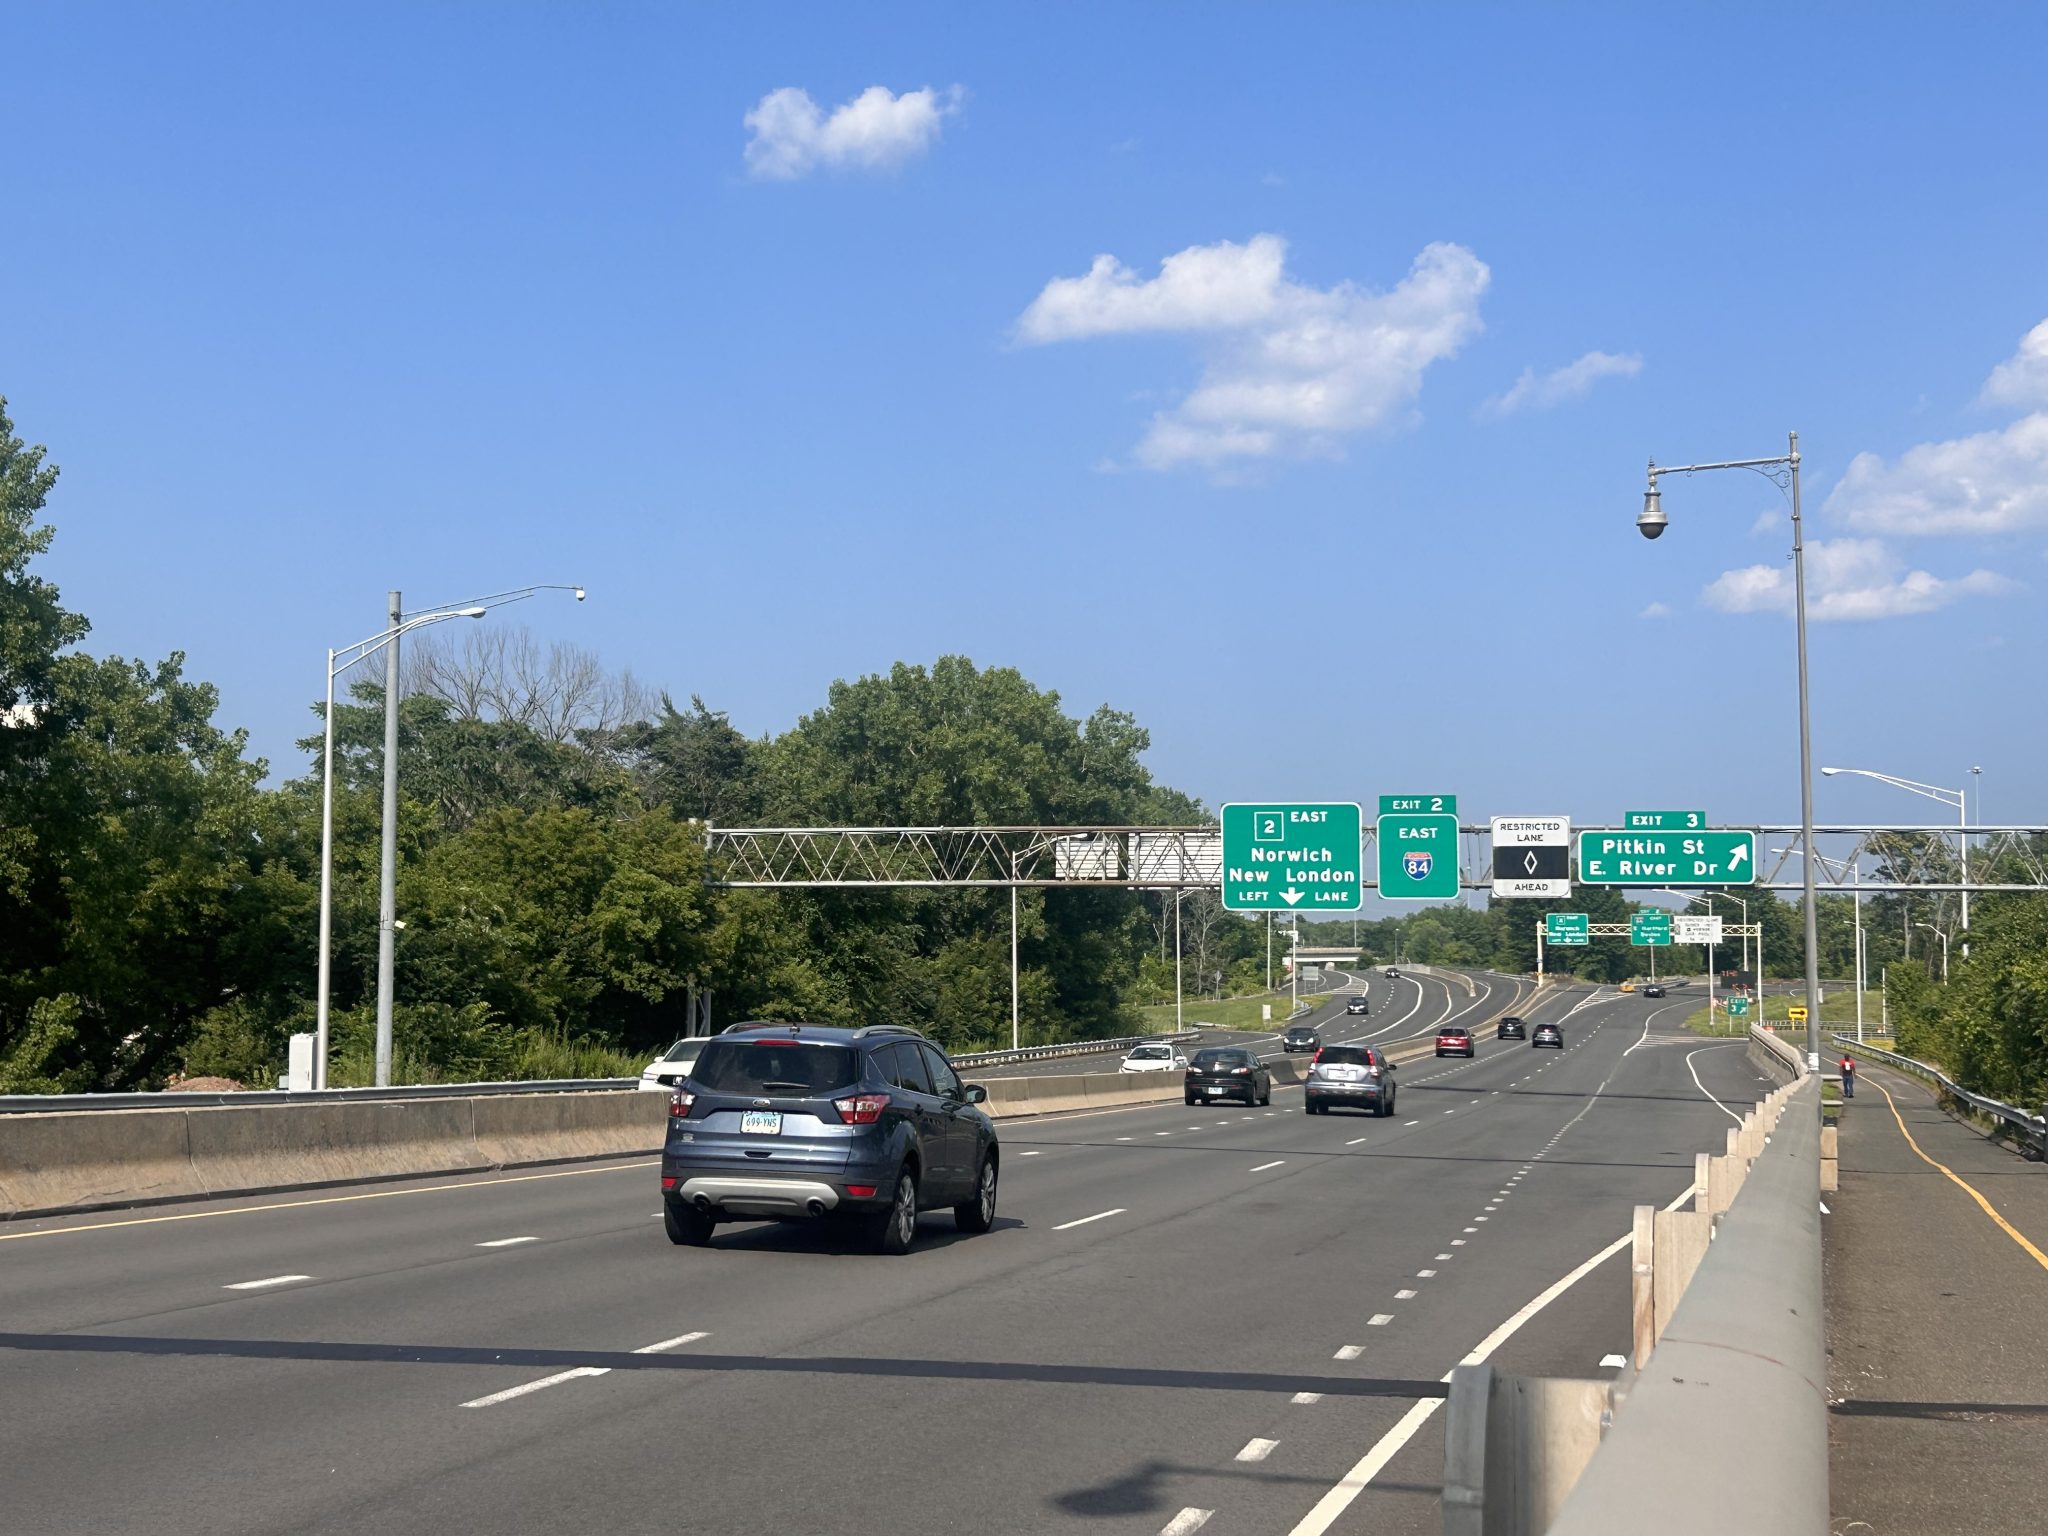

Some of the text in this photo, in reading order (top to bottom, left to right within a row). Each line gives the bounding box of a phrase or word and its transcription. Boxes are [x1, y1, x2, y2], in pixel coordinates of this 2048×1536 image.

[1392, 797, 1443, 812] EXIT 2
[1263, 811, 1328, 834] 2 EAST
[1500, 823, 1560, 831] RESTRICTED
[1632, 813, 1699, 828] EXIT 3
[1399, 827, 1438, 839] EAST
[1517, 834, 1544, 842] LANE
[1602, 839, 1705, 855] Pitkin St
[1251, 847, 1332, 862] Norwich
[1229, 868, 1355, 882] New London
[1407, 861, 1429, 875] 84
[1619, 861, 1677, 876] River
[1693, 861, 1718, 876] Dr
[1514, 883, 1549, 891] AHEAD
[1239, 891, 1349, 902] LEFT LANE
